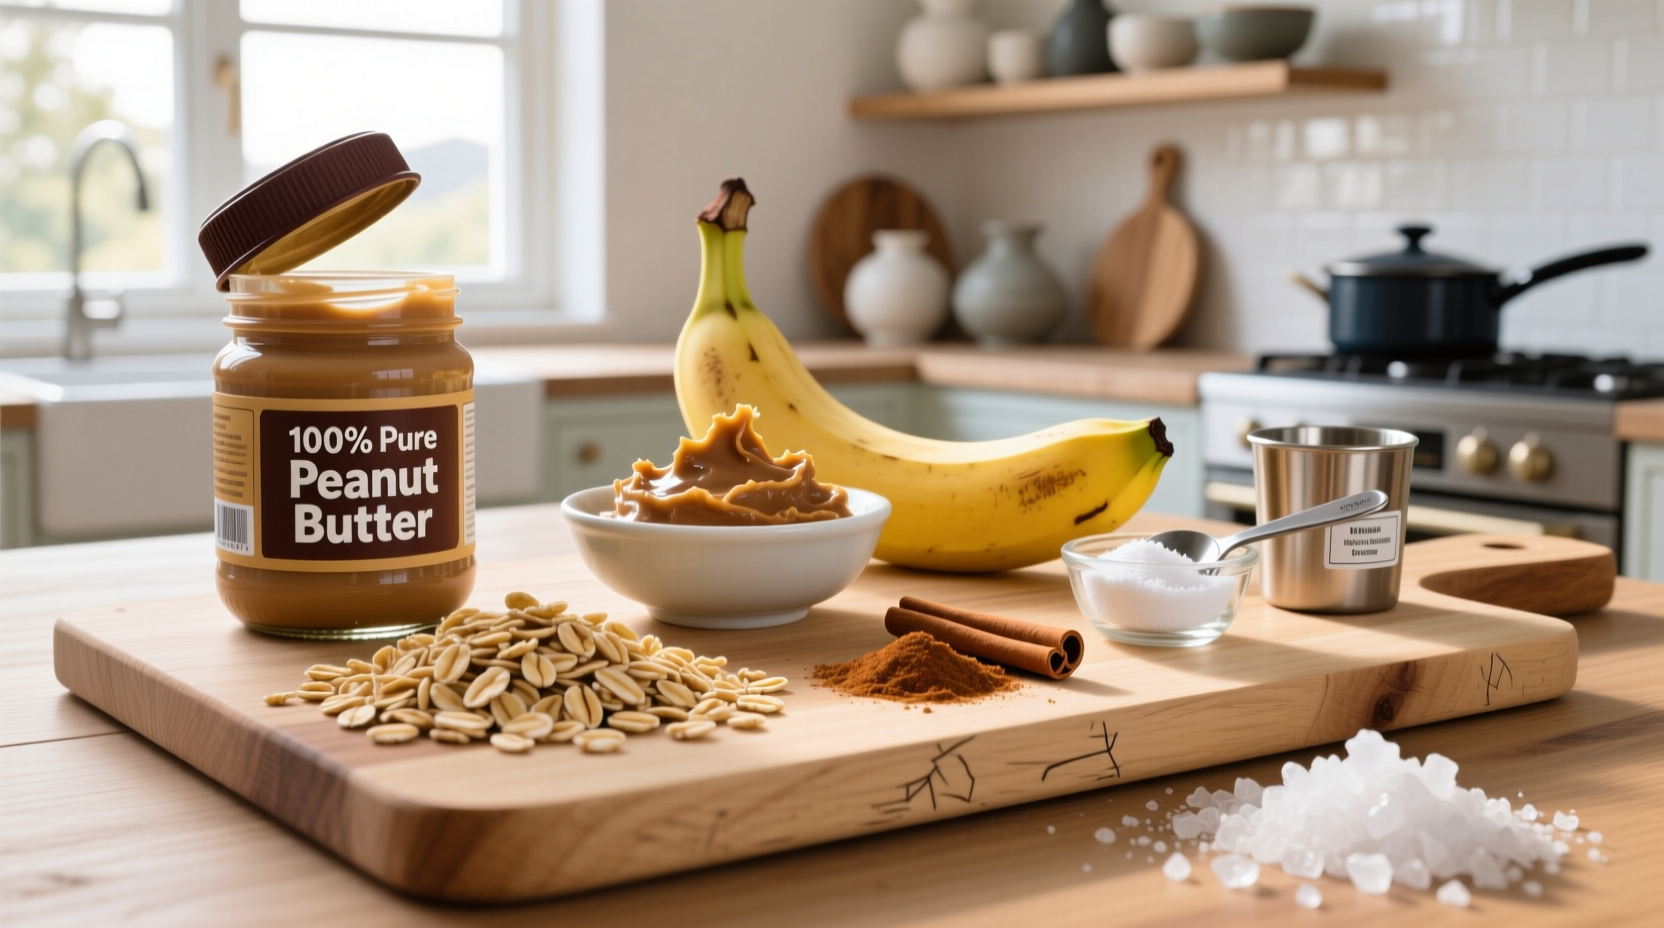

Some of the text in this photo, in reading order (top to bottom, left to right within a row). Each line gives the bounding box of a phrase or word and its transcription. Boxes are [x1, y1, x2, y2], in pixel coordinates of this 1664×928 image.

[289, 426, 437, 454] 100% Pure
[290, 457, 439, 500] Peanut
[294, 503, 433, 544] Butter
